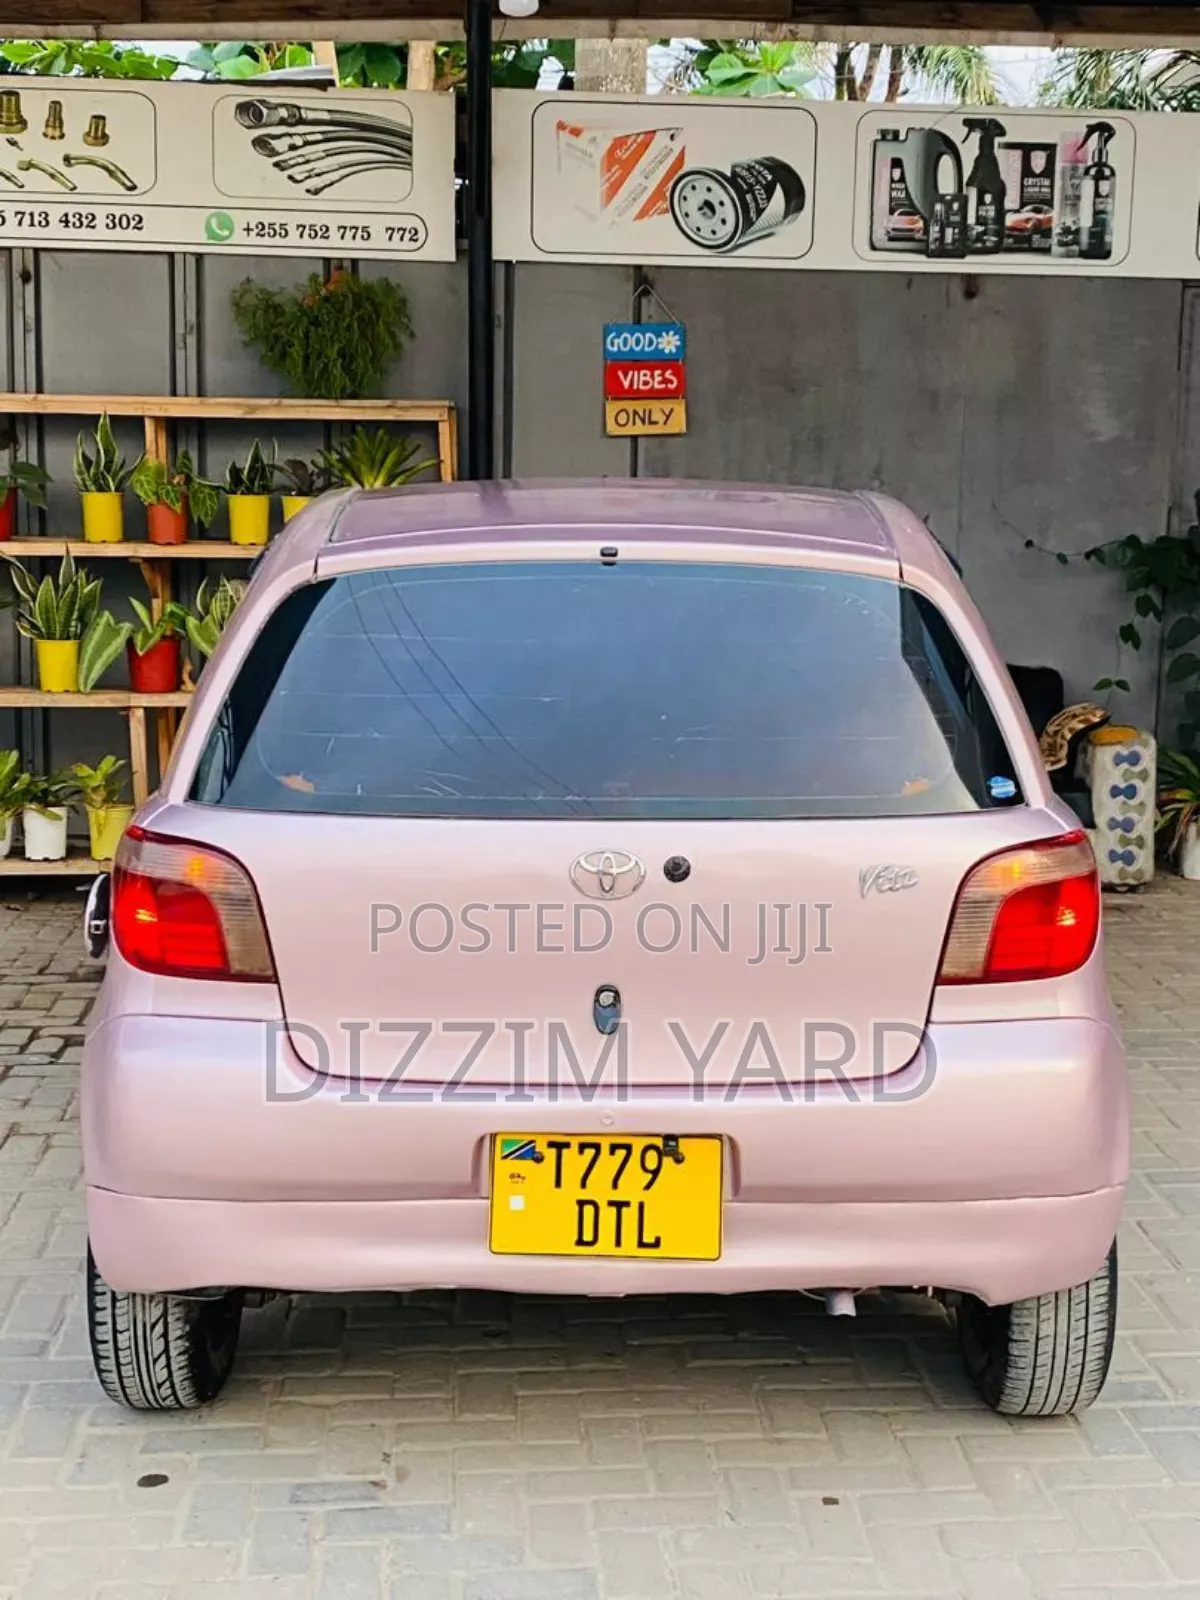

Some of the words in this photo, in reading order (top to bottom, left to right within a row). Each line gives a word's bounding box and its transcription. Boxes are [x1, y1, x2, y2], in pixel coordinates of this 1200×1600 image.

[14, 210, 51, 229] 713
[58, 211, 97, 230] 432
[104, 212, 145, 232] 302
[242, 221, 290, 239] +255
[296, 223, 331, 240] 752
[337, 225, 372, 241] 775
[384, 226, 420, 243] 772
[606, 331, 658, 352] GOOD
[617, 369, 679, 390] VIBES
[614, 406, 675, 428] ONLY
[547, 1140, 664, 1191] T779
[574, 1199, 662, 1249] DTL
